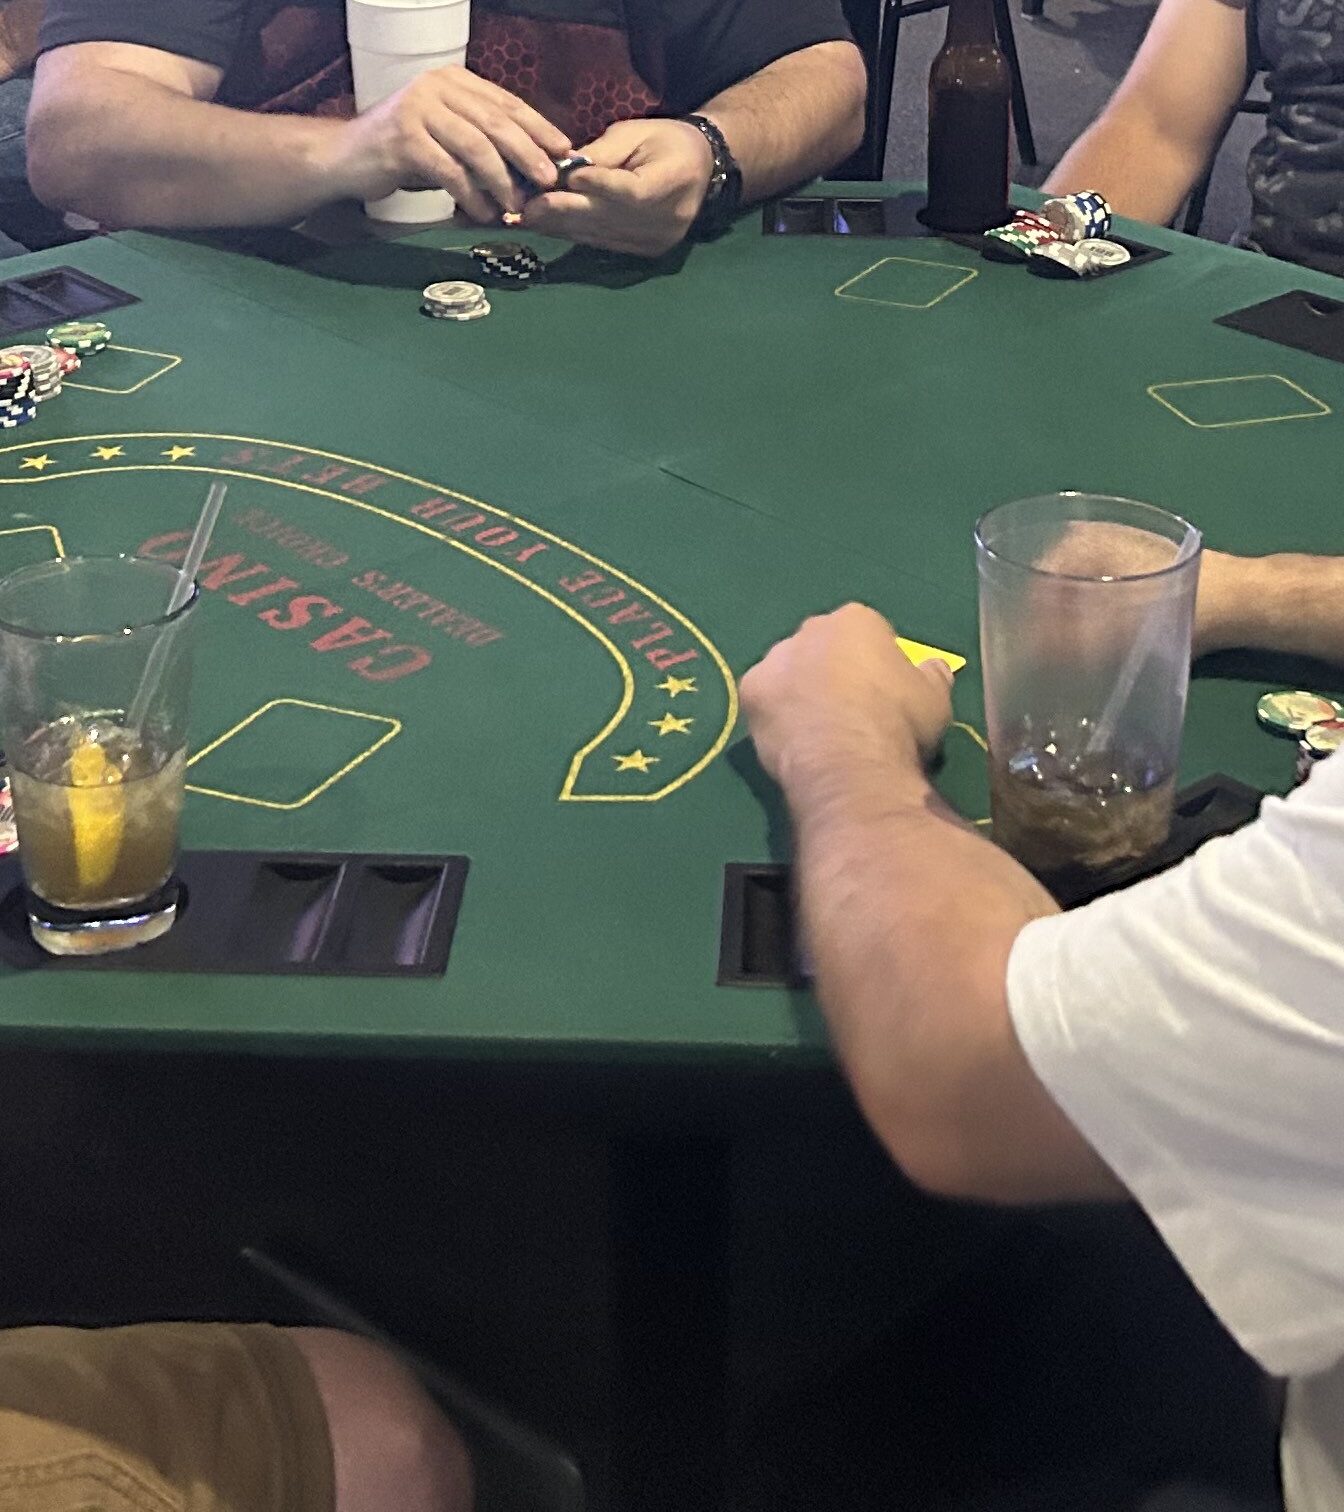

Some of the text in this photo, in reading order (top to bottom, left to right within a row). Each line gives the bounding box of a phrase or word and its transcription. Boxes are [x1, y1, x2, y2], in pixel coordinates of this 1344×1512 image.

[136, 530, 432, 682] CASINO
[221, 448, 699, 670] PLACE YOUR BETS
